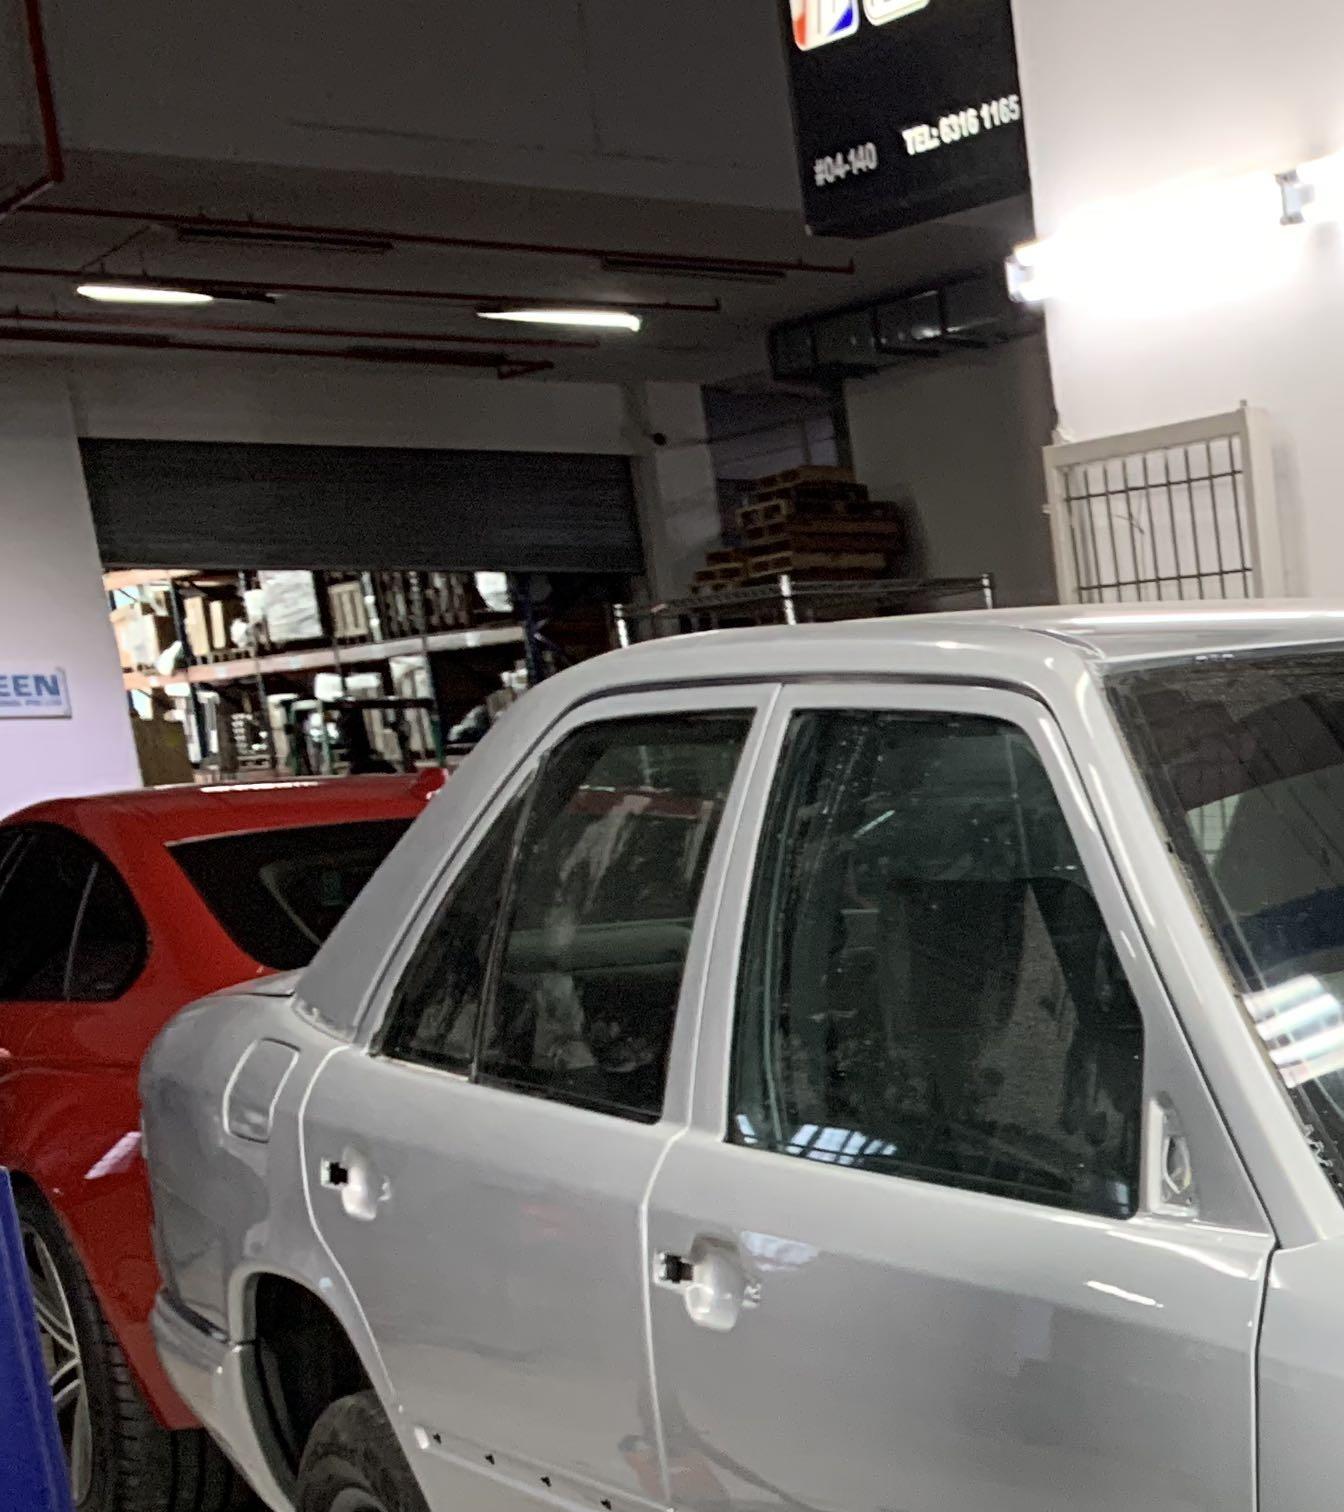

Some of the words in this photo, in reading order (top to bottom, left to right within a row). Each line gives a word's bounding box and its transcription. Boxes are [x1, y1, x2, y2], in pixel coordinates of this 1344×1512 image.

[902, 124, 940, 156] TEL:
[939, 108, 980, 144] 6316
[980, 95, 1021, 130] 1165
[813, 142, 878, 187] #04-140
